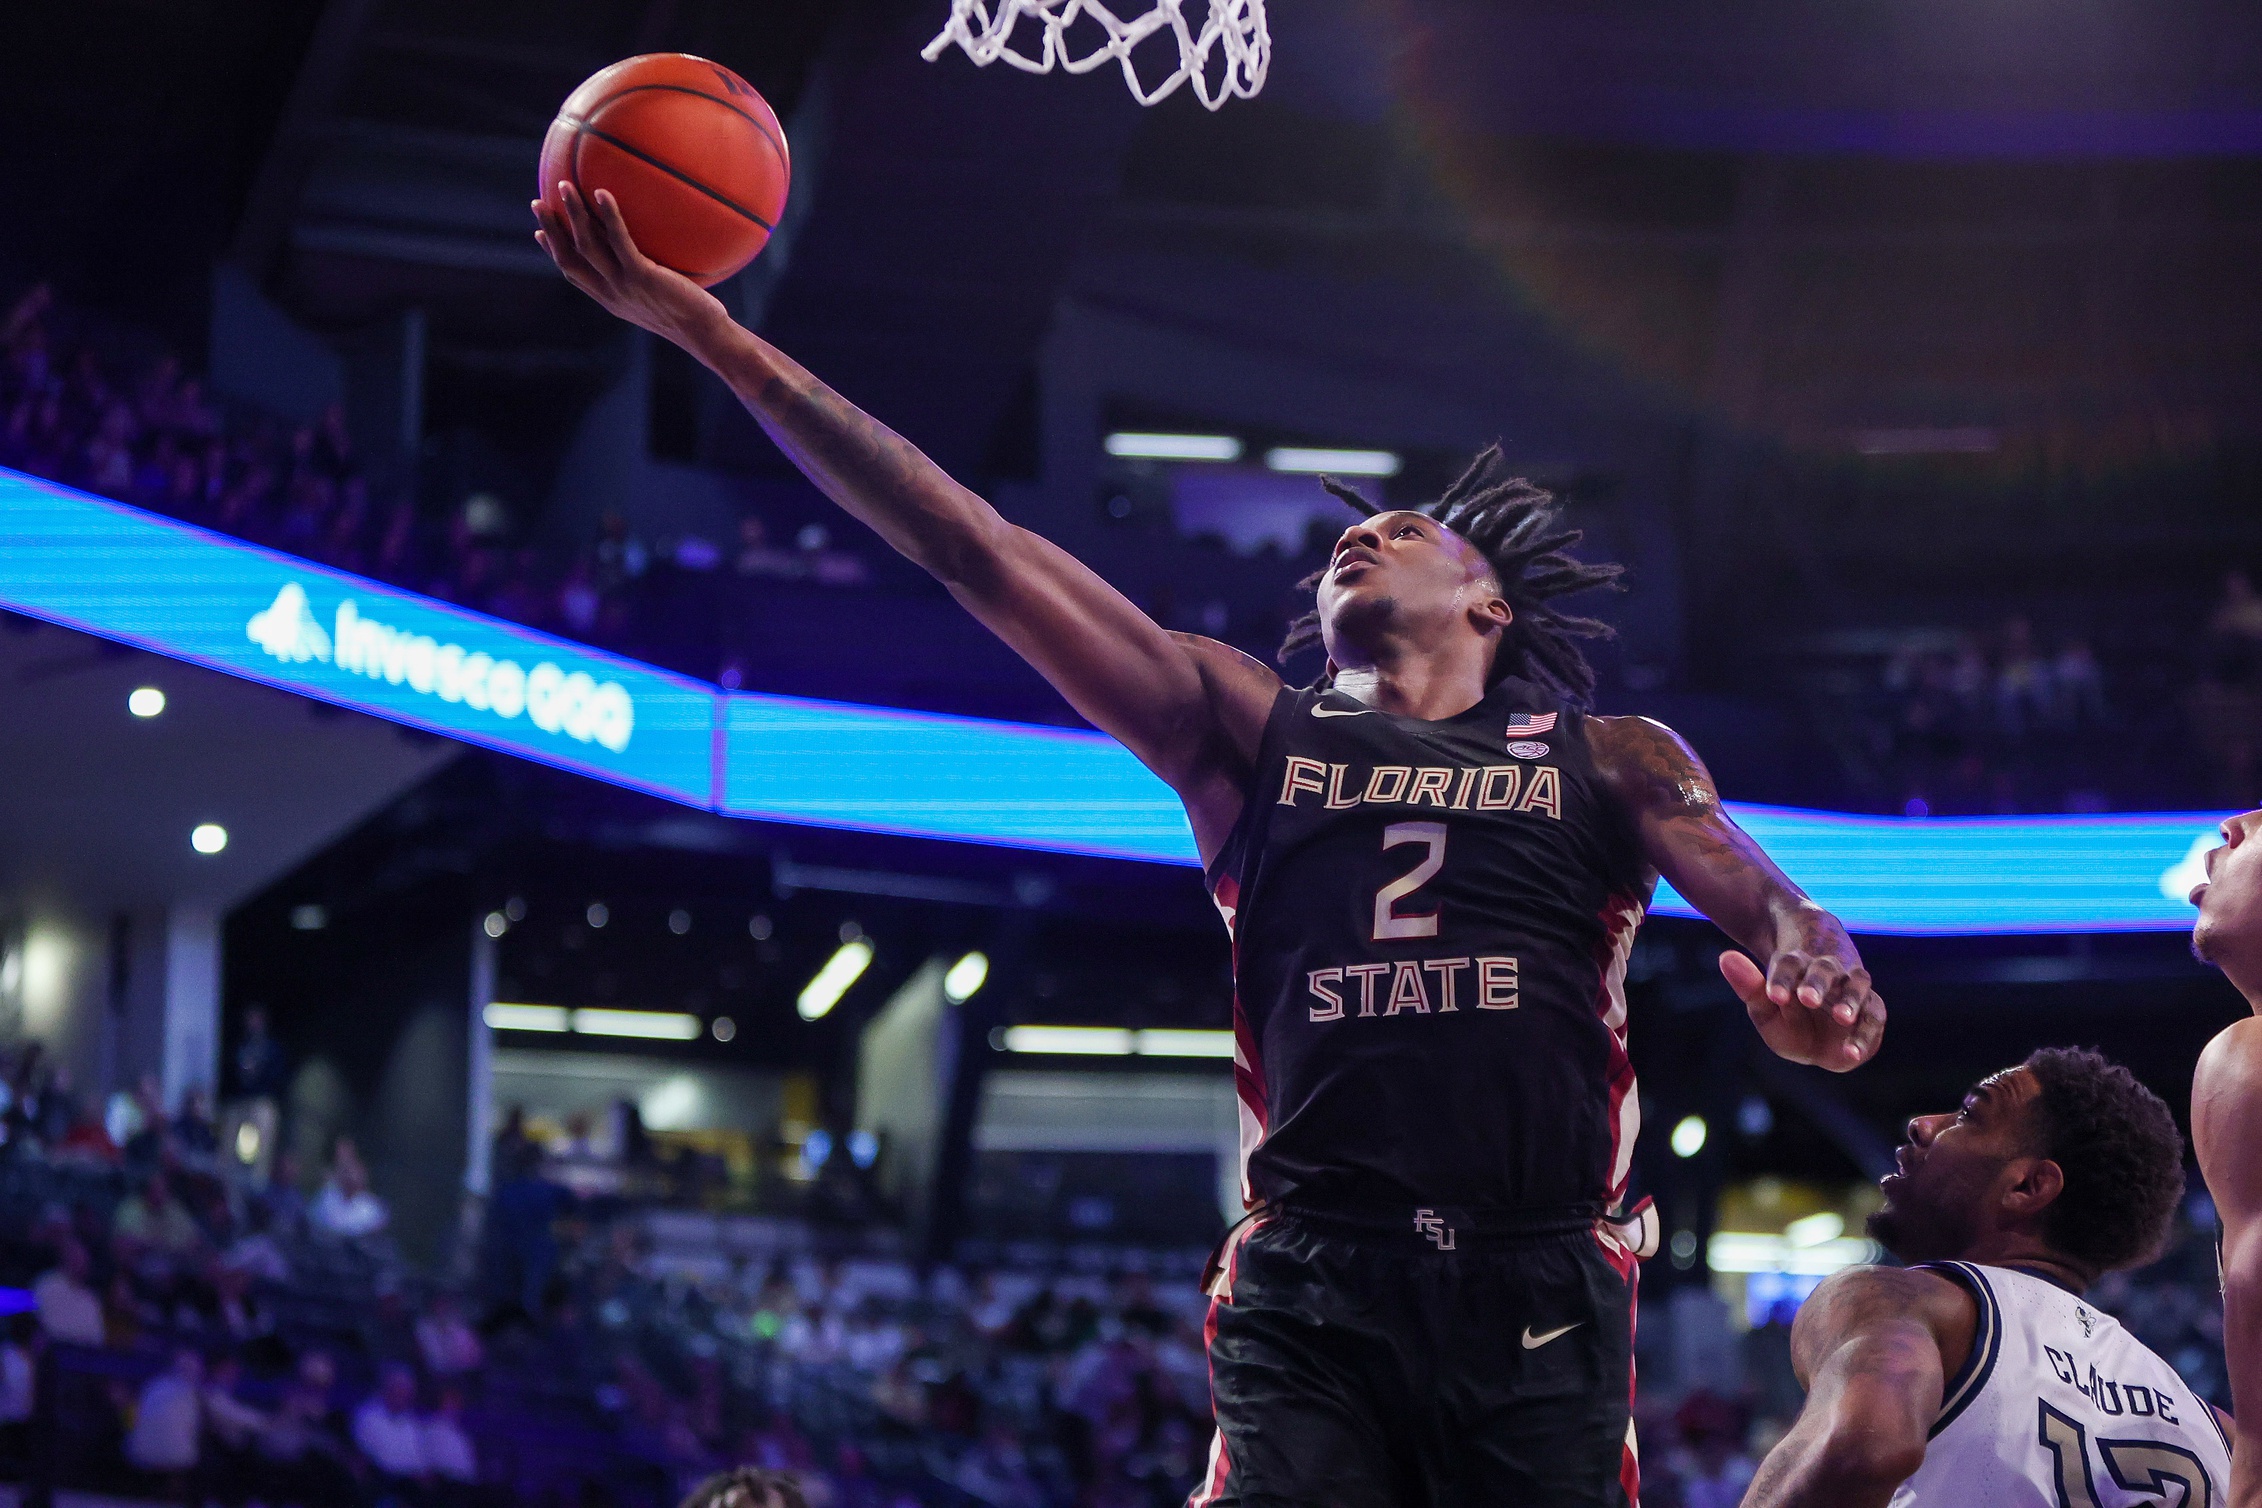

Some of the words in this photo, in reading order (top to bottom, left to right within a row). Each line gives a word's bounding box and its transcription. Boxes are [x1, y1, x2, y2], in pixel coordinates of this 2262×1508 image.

[334, 599, 526, 719] Invesco
[1276, 755, 1562, 820] FLORIDA
[1371, 821, 1448, 941] 2
[1307, 956, 1519, 1022] STATE
[1413, 1209, 1456, 1250] FSU
[2044, 1345, 2180, 1426] CLAUDE
